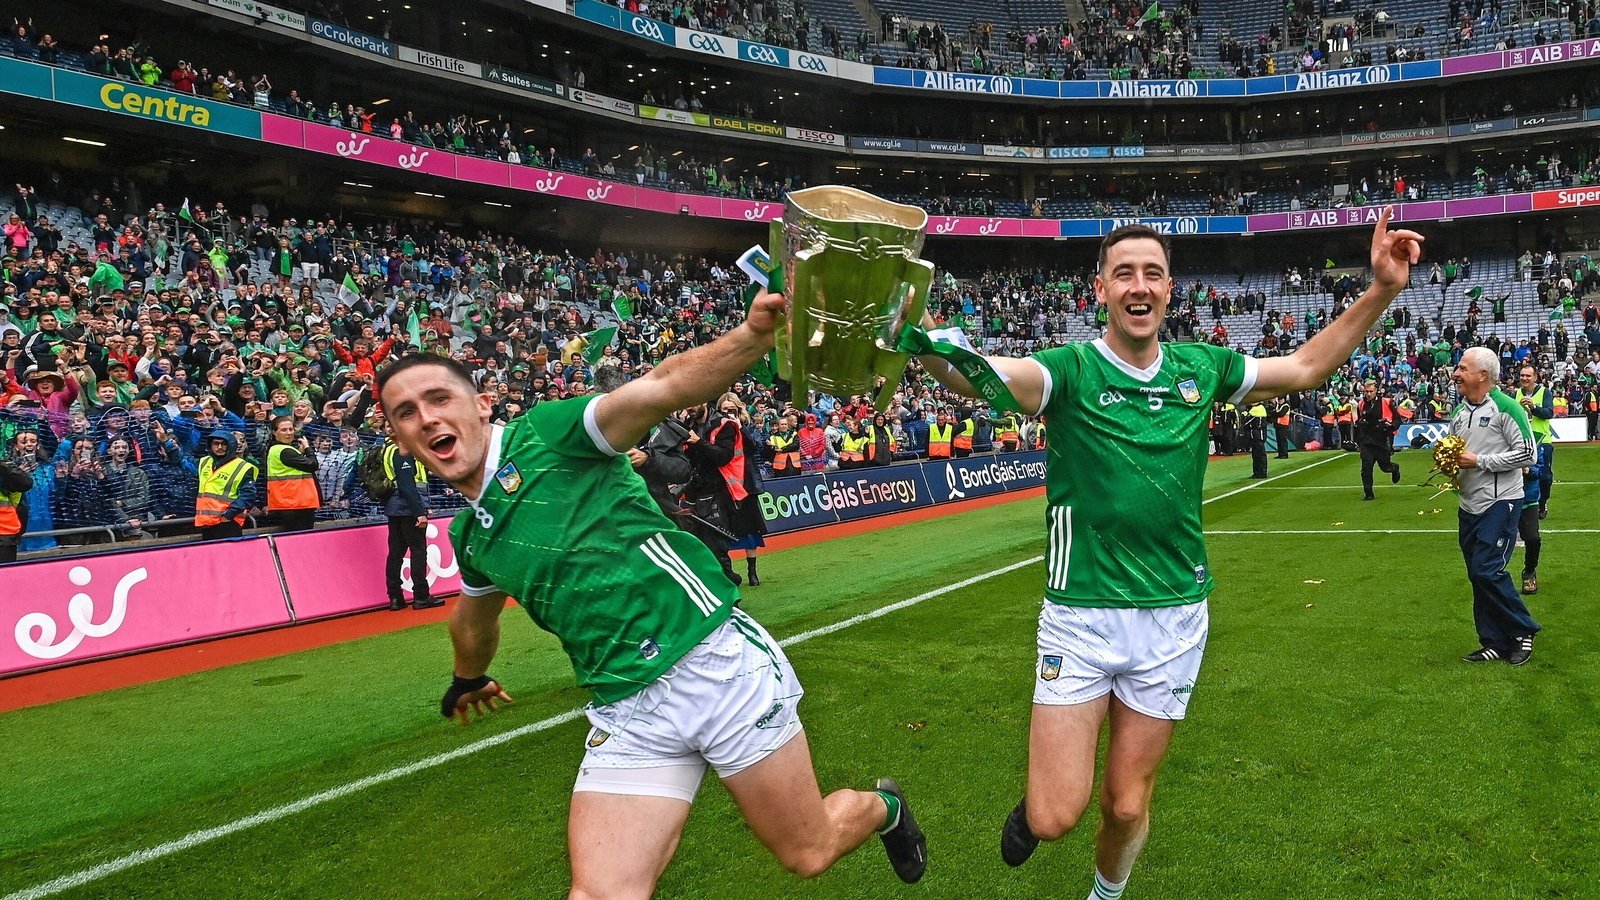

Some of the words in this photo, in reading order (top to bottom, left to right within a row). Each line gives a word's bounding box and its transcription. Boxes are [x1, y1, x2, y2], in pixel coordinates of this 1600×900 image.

[287, 14, 305, 26] bam
[631, 16, 665, 41] GAA
[311, 21, 390, 56] @CrokePark
[688, 33, 724, 54] GAA
[416, 51, 443, 68] Irish
[443, 56, 465, 73] Life
[747, 45, 780, 64] GAA
[797, 54, 828, 72] GAA
[1530, 46, 1563, 64] AIB
[501, 72, 531, 88] Suites
[923, 71, 986, 93] Allianz
[1108, 80, 1171, 98] Allianz
[1296, 69, 1362, 90] Allianz
[99, 82, 211, 127] Centra
[713, 117, 746, 131] GAEL
[747, 122, 783, 136] FORM
[797, 128, 835, 141] TESCO
[335, 131, 370, 157] eir
[863, 138, 902, 149] www.cgl.ie
[930, 142, 967, 153] www.cgl.ie
[1351, 134, 1375, 143] PADDY
[397, 145, 430, 169] eir
[1049, 146, 1090, 158] CISCO
[1113, 146, 1145, 157] CISCO
[535, 171, 564, 193] eir
[586, 180, 613, 201] eir
[744, 202, 769, 221] eir
[1308, 211, 1338, 226] AIB
[936, 217, 960, 234] eir
[979, 218, 1002, 235] eir
[1147, 393, 1164, 411] 5
[961, 465, 991, 489] Bord
[990, 460, 1017, 485] Gáis
[757, 485, 815, 521] Bord
[814, 480, 859, 512] Gáis
[859, 478, 917, 505] Energy
[475, 506, 494, 529] 8
[14, 565, 148, 659] eir
